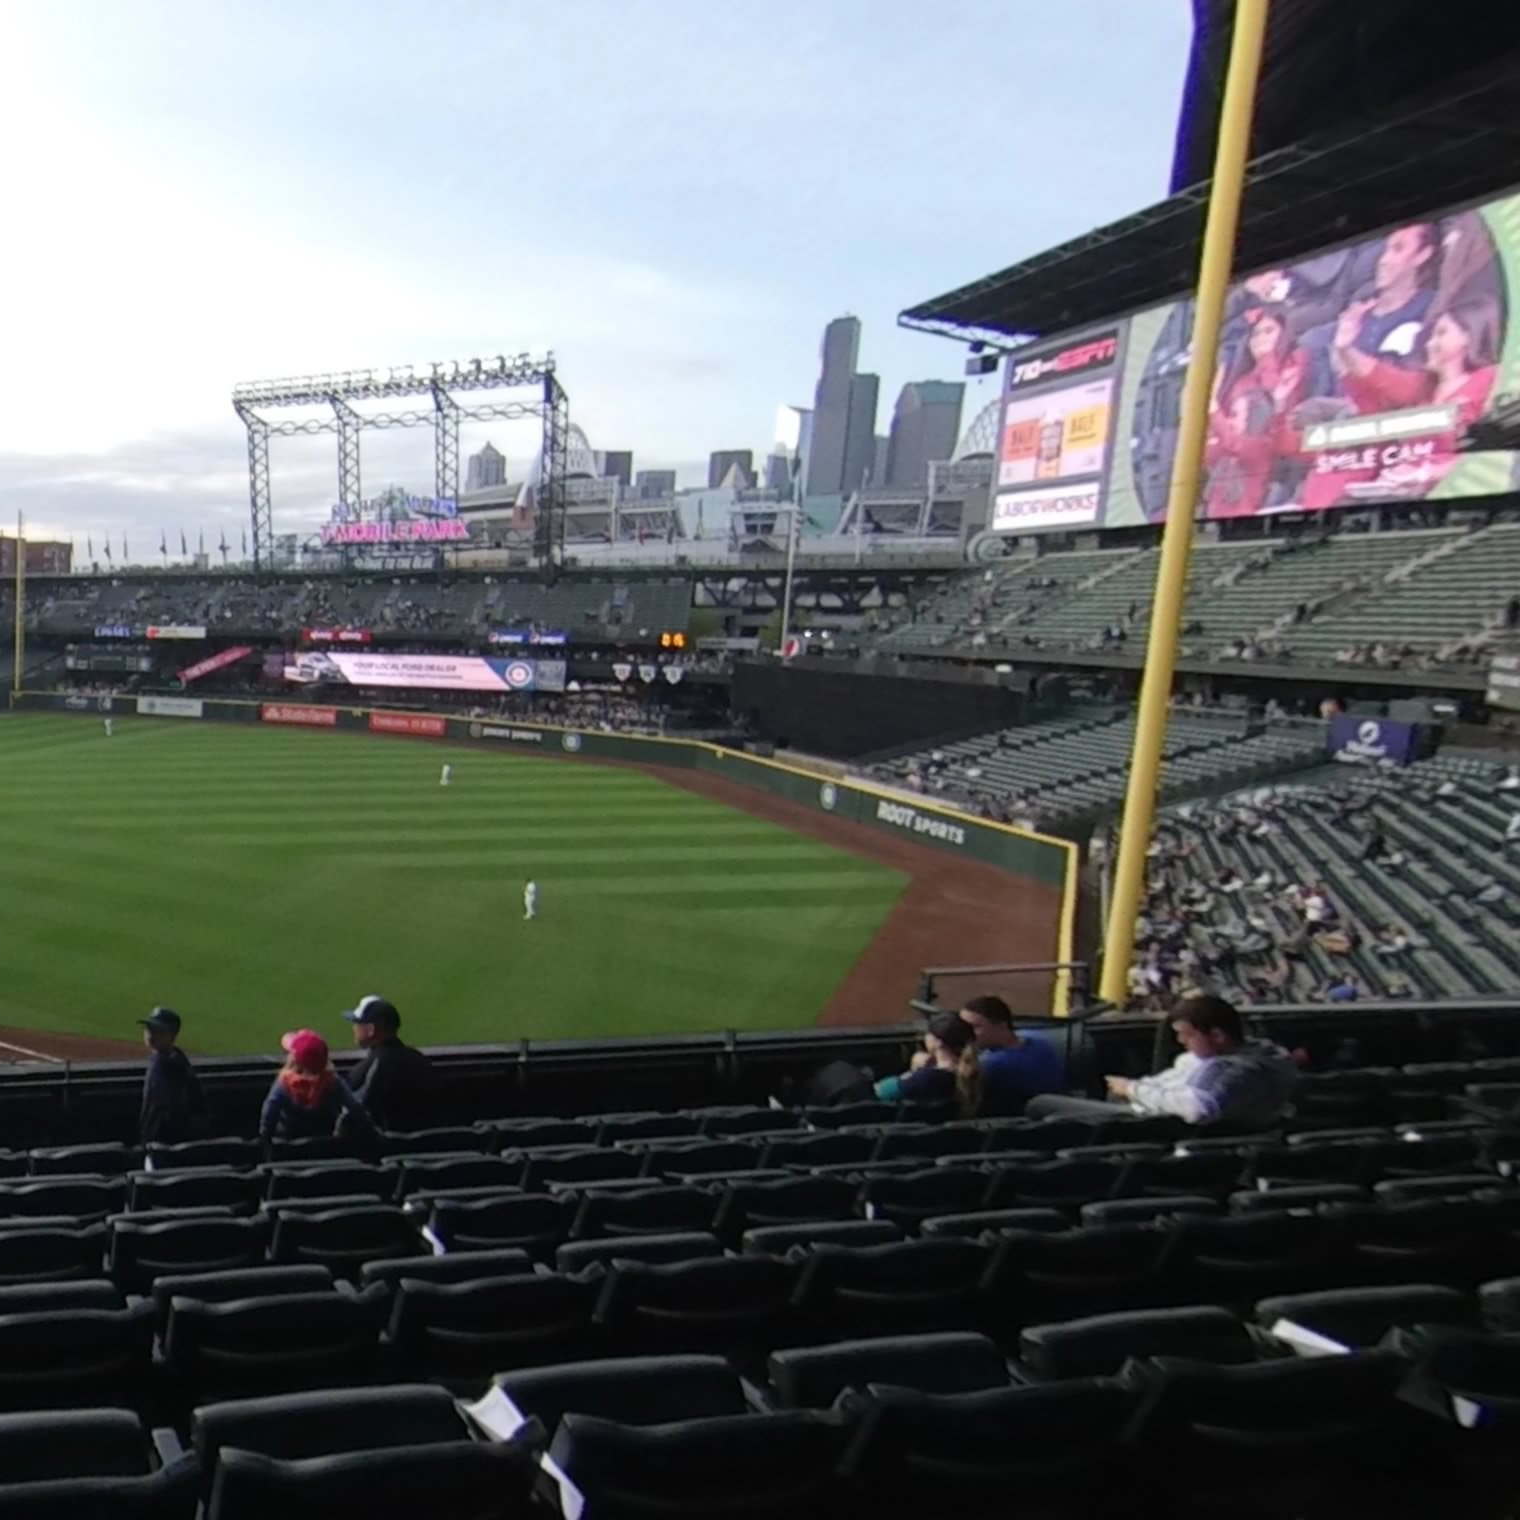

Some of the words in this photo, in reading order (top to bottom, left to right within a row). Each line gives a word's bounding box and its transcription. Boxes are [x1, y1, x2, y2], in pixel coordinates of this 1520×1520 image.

[1013, 359, 1042, 383] 710
[1316, 449, 1378, 474] SMILE
[1381, 441, 1436, 466] CAM
[412, 517, 469, 541] PARK
[877, 801, 916, 829] ROOT
[913, 814, 965, 845] SPORTS
